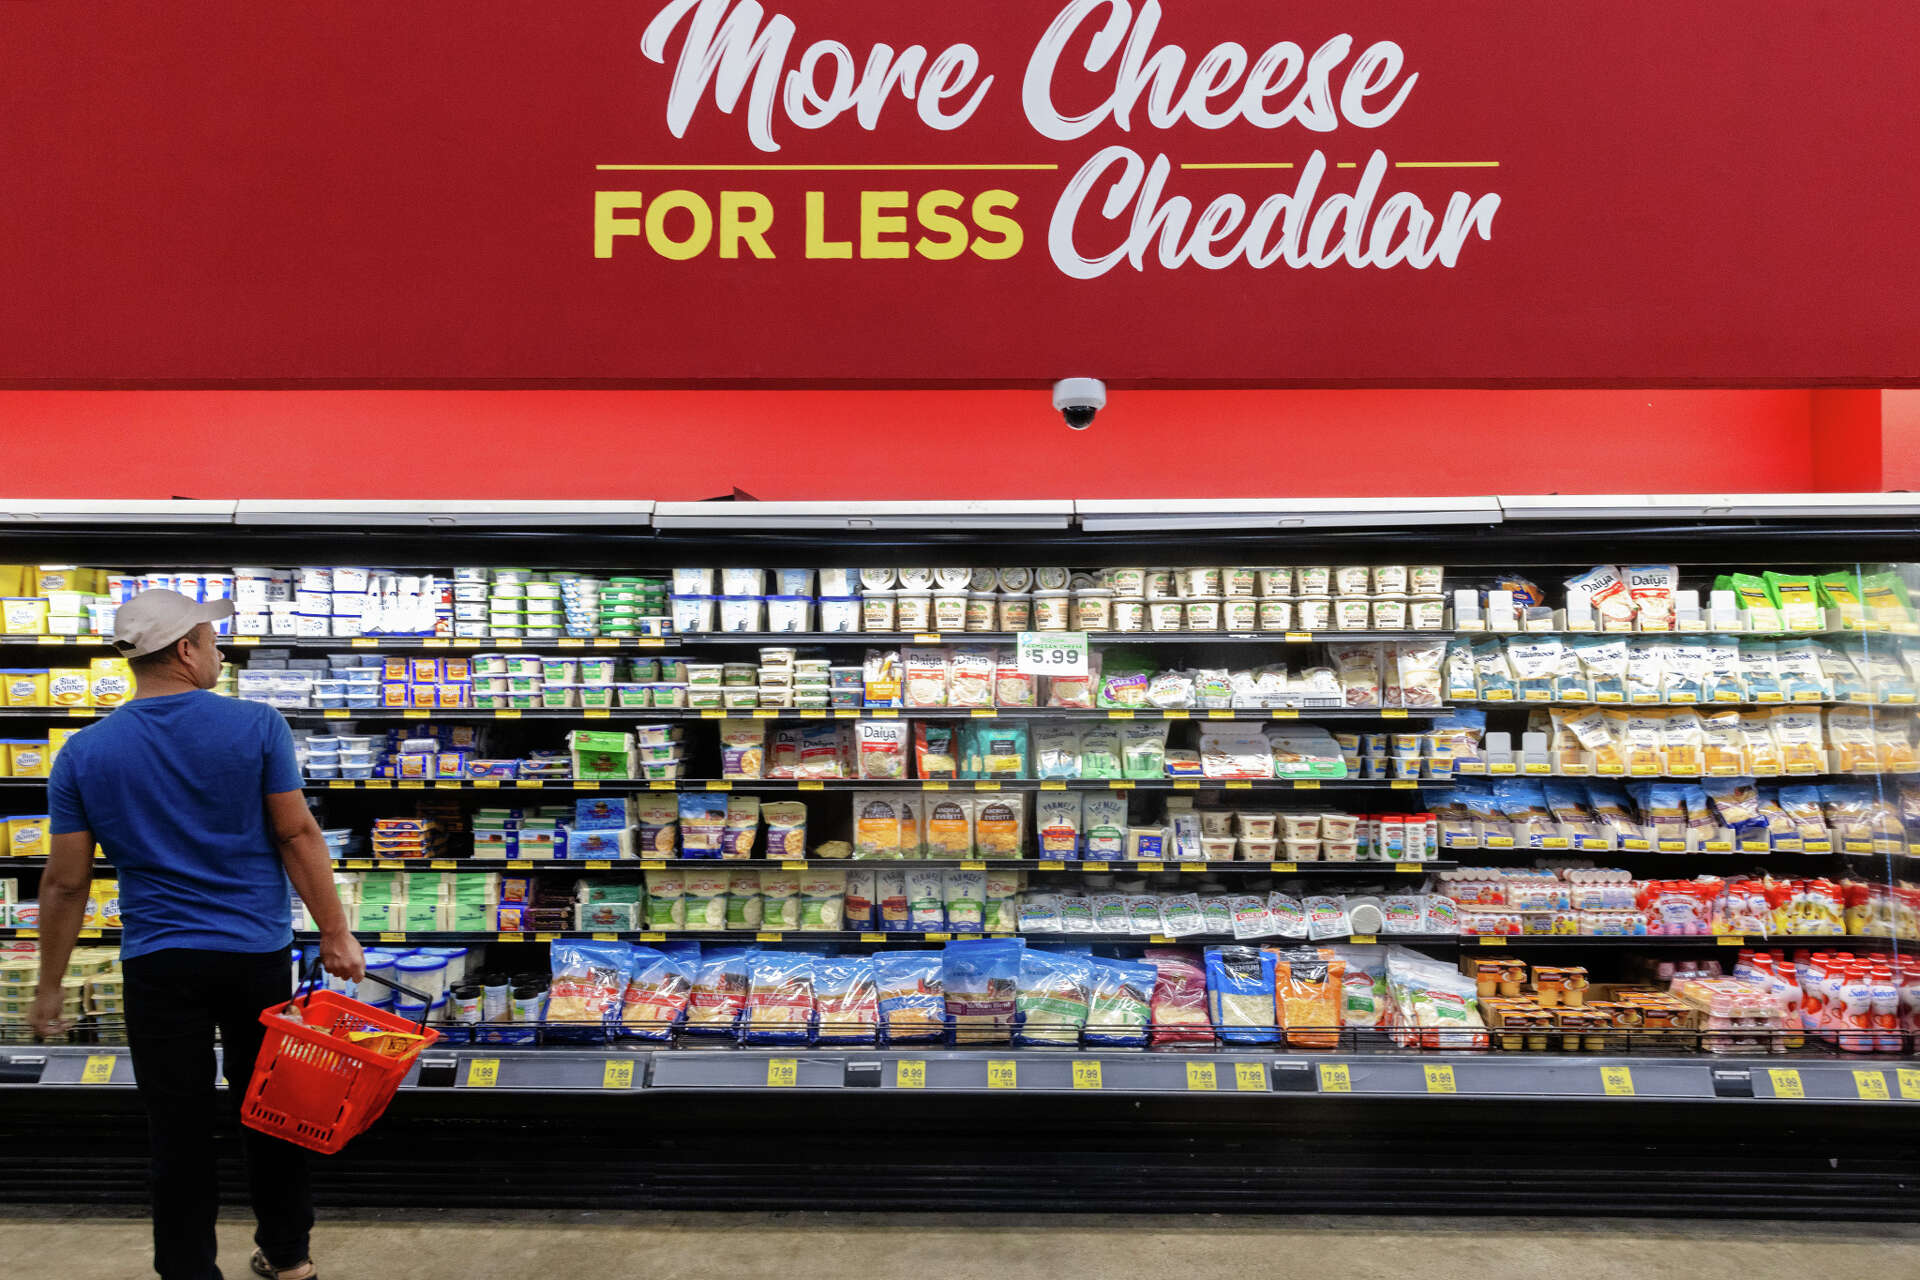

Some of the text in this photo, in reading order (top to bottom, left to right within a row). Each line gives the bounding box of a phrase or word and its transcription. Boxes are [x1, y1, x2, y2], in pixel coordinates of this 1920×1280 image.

[641, 0, 1418, 152] More Cheese
[593, 145, 1502, 280] FOR LESS Cheddar
[1580, 574, 1614, 593] Daiya
[1631, 574, 1668, 587] Daiya
[910, 654, 942, 668] Daiya
[1025, 649, 1079, 664] $5.99
[864, 726, 897, 741] Daiya
